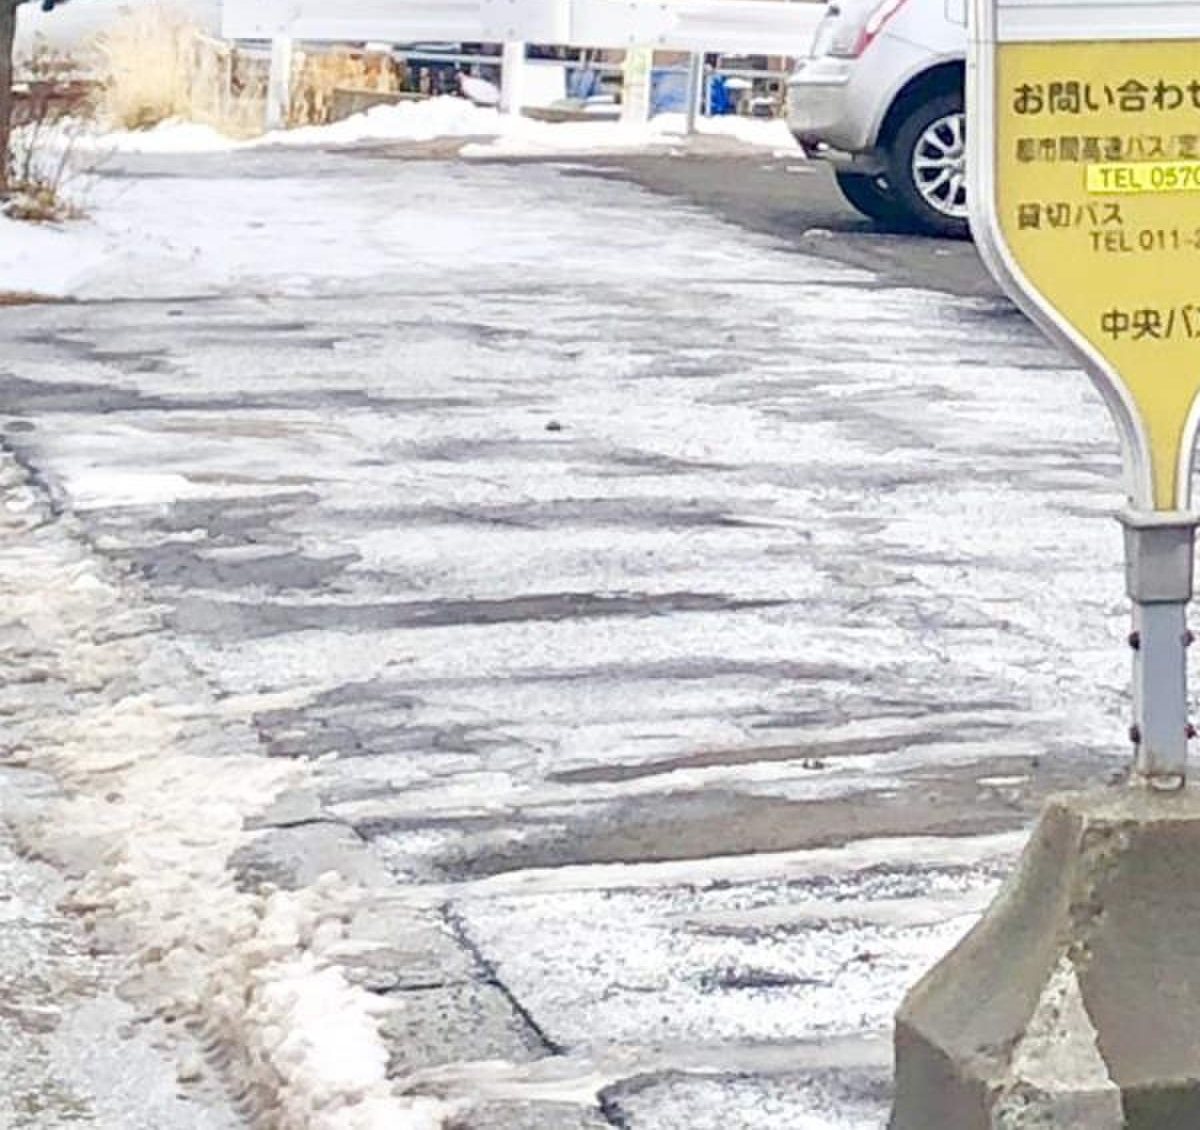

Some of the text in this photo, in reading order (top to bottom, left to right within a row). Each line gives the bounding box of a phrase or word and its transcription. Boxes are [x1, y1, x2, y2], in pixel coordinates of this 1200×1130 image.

[1100, 168, 1142, 189] TEL
[1017, 202, 1124, 230] 貸切バス
[1090, 231, 1133, 253] TEL
